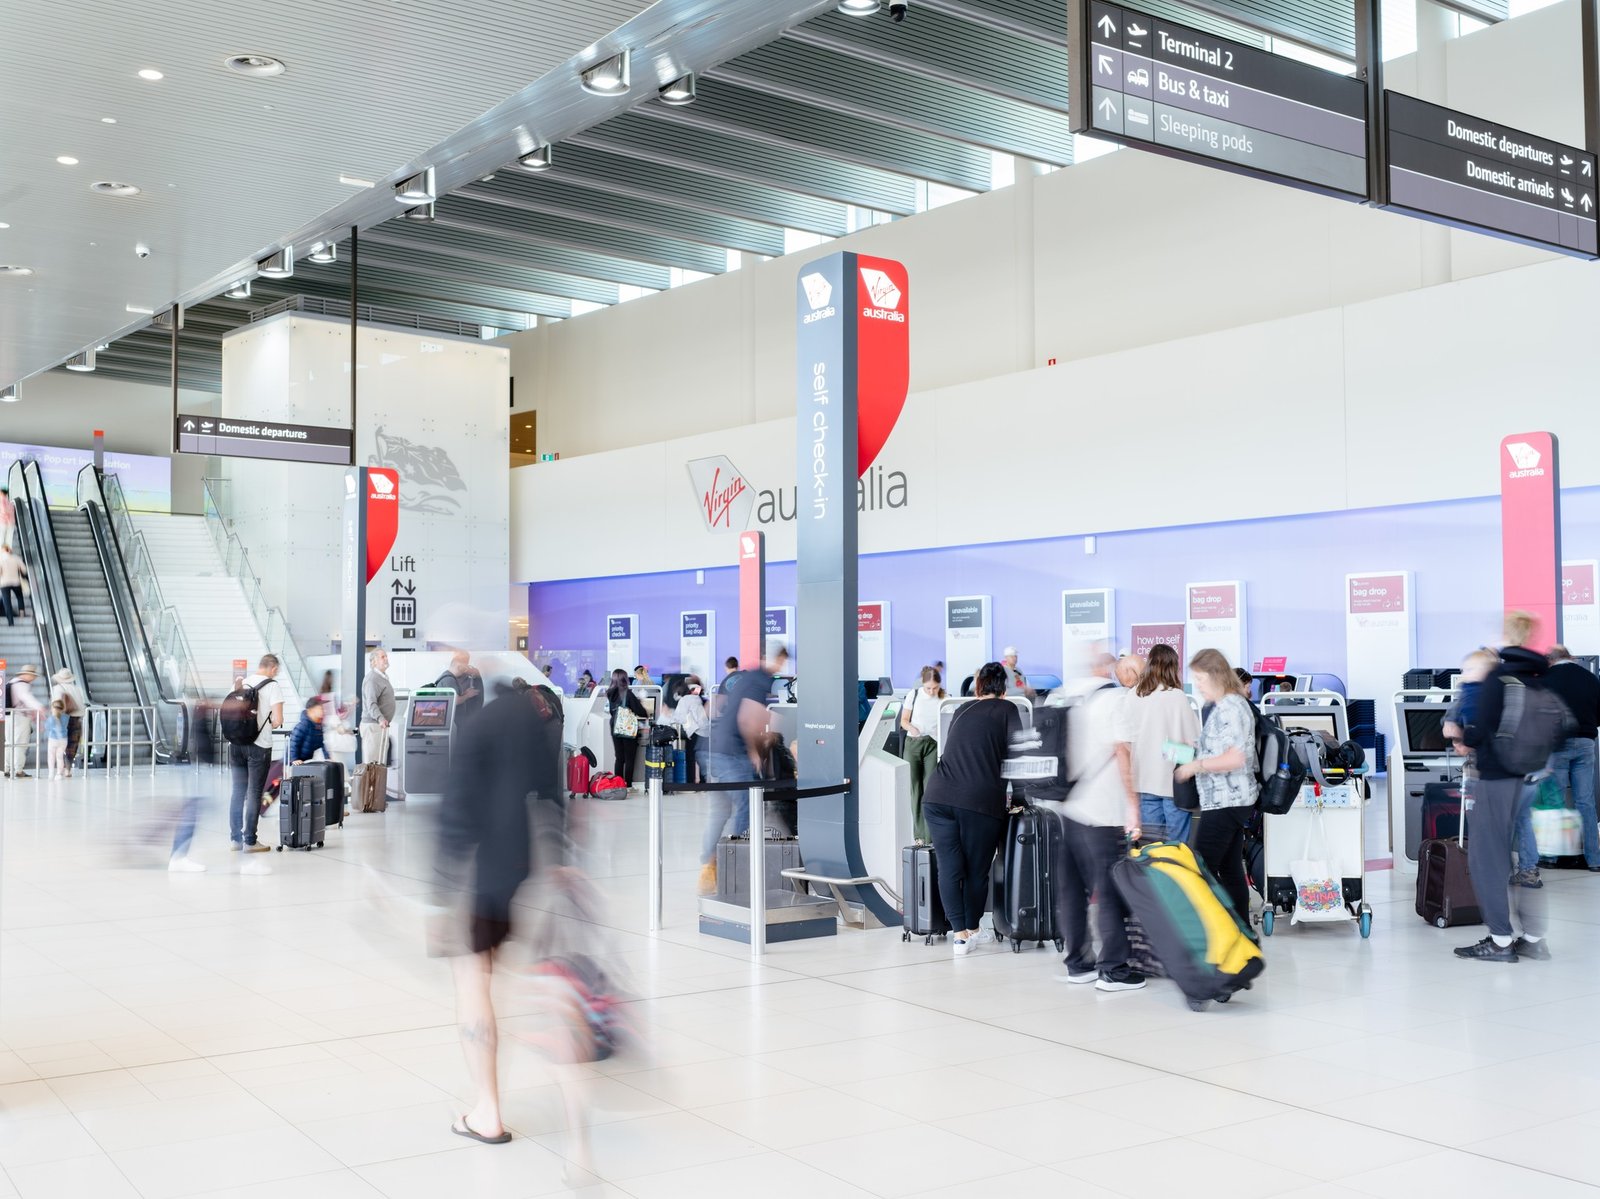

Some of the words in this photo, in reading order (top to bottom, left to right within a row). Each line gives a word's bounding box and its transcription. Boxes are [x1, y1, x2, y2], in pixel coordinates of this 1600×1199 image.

[1158, 30, 1221, 67] Terminal
[1224, 51, 1234, 70] 2
[1158, 71, 1186, 96] Bus
[1188, 81, 1200, 100] &
[1203, 87, 1230, 109] taxi
[1160, 114, 1219, 149] Sleeping
[1222, 134, 1254, 154] pods
[1447, 119, 1497, 150] Domestic
[1499, 135, 1554, 166] departures
[1466, 160, 1516, 189] Domestic
[1517, 177, 1555, 200] arrivals
[871, 276, 896, 305] Virgin
[803, 306, 835, 324] australia
[863, 307, 905, 323] australia
[813, 362, 829, 405] self
[218, 422, 260, 436] Domestic
[261, 426, 307, 440] departures
[813, 410, 829, 520] check-in
[1509, 467, 1545, 479] australia
[703, 467, 747, 529] Virgin
[757, 466, 909, 524] aualia
[391, 555, 416, 573] Lift
[1192, 595, 1205, 605] bag
[1206, 595, 1223, 604] drop
[1353, 587, 1367, 597] bag
[1369, 587, 1387, 597] drop
[951, 606, 978, 614] unavailable
[1069, 600, 1100, 609] unavailable
[1136, 635, 1155, 645] how
[1156, 636, 1165, 645] to
[1166, 634, 1181, 644] self
